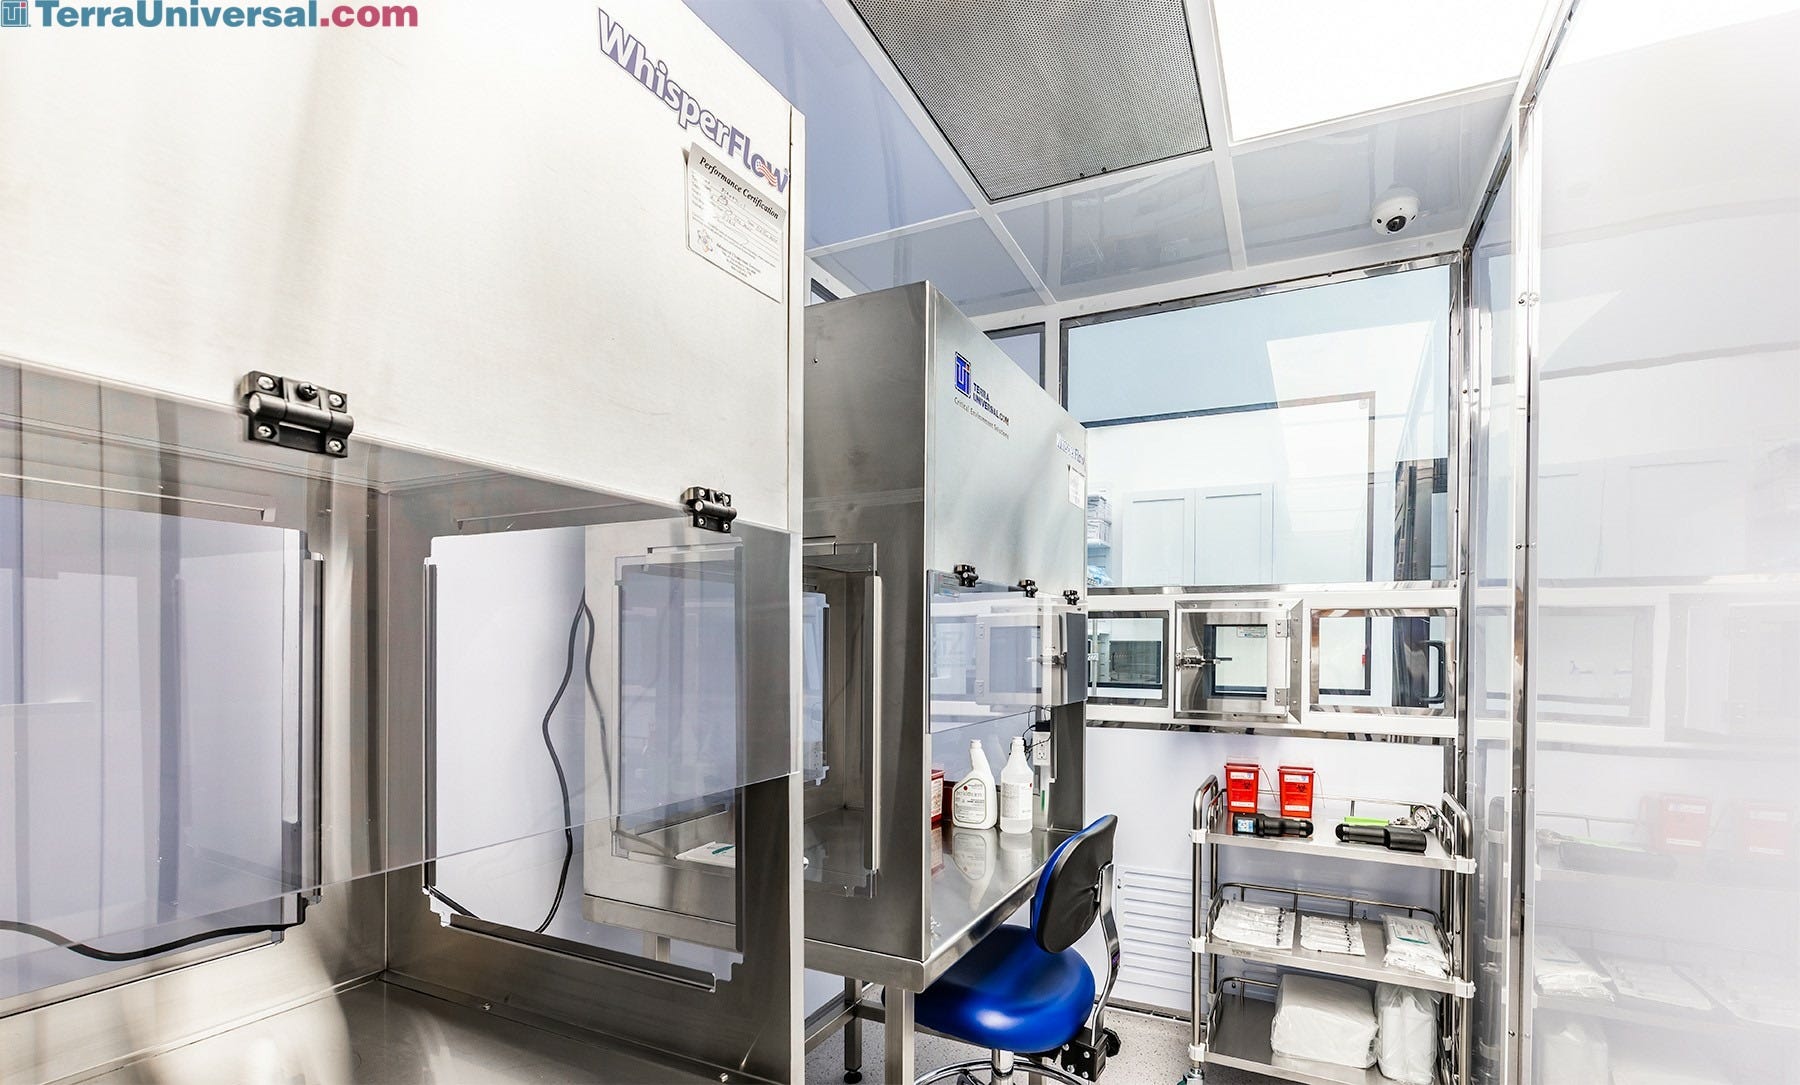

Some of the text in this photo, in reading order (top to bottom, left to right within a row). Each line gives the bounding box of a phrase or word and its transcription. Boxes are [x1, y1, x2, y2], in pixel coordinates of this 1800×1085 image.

[598, 8, 788, 193] WhisperFlow
[699, 156, 778, 220] Performance Certification
[973, 382, 990, 402] TERRA
